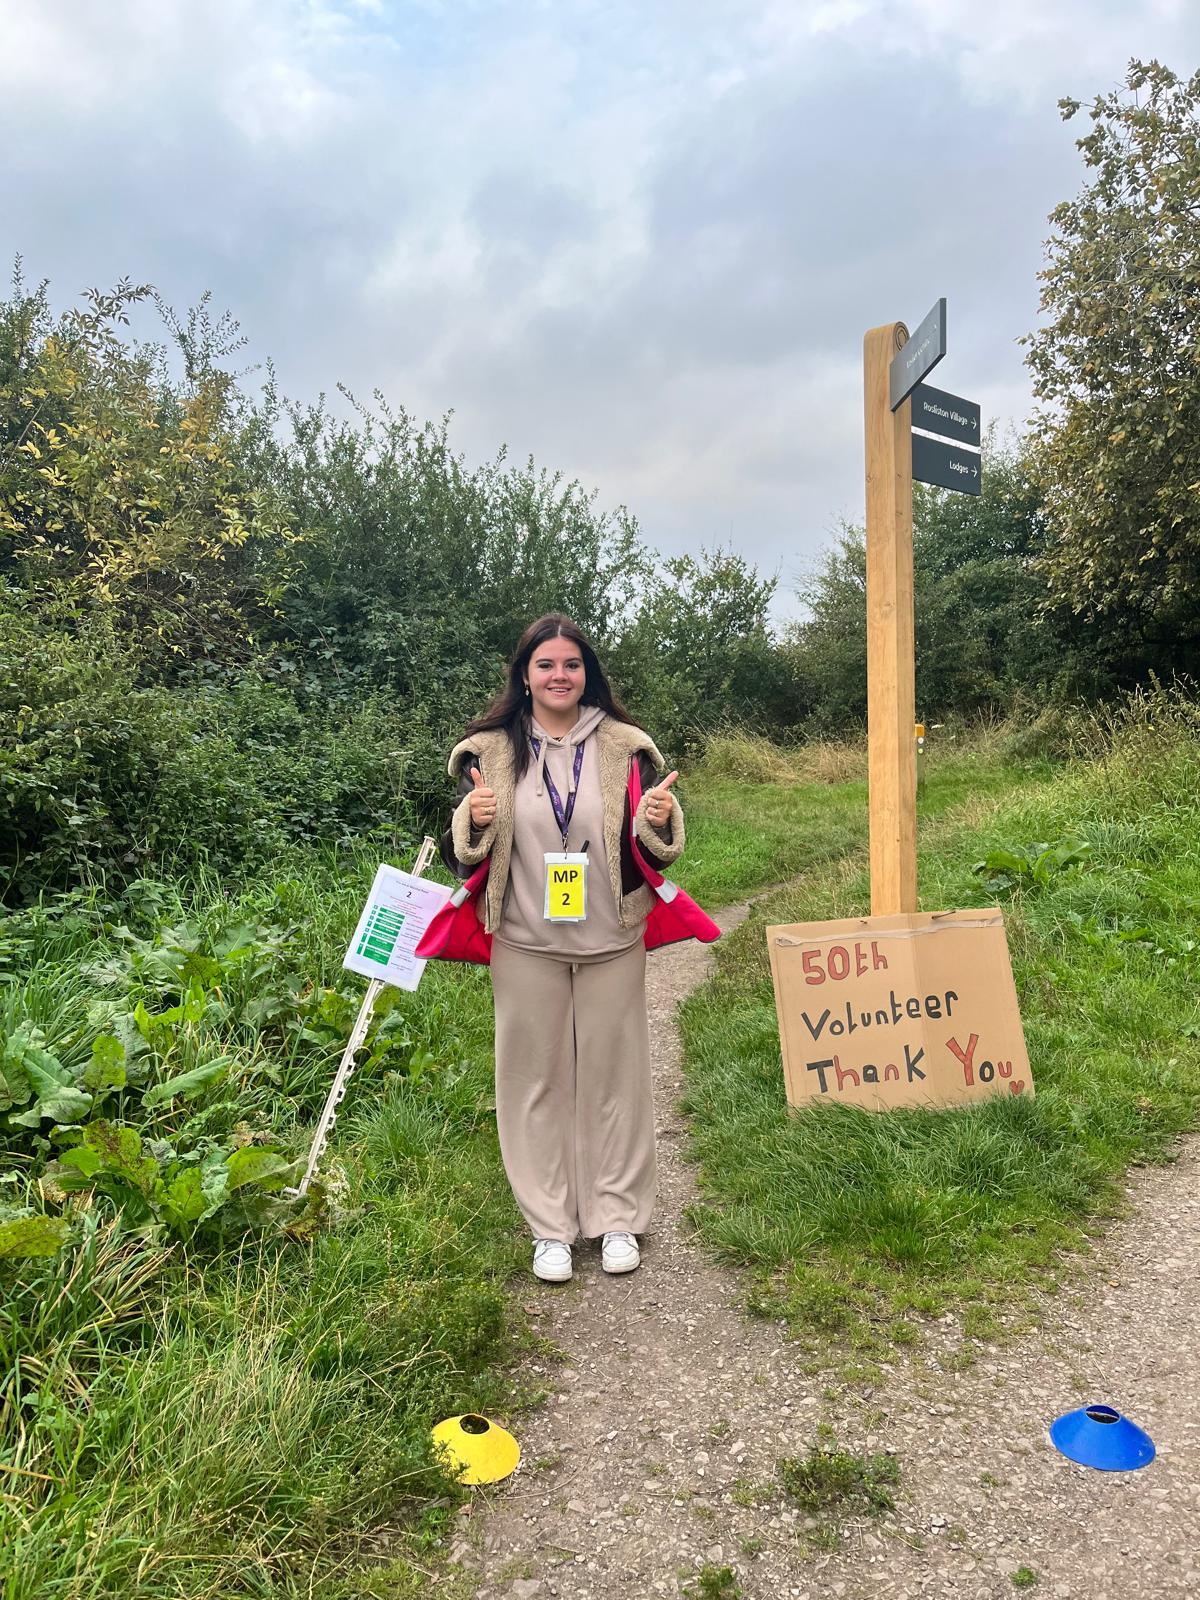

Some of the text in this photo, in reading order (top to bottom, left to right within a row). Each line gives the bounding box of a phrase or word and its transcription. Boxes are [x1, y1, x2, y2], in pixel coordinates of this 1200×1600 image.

[923, 402, 968, 425] Rosliston Village
[949, 460, 969, 474] Lodges
[553, 870, 578, 883] MP
[561, 893, 570, 905] 2
[802, 942, 888, 985] 50th
[801, 990, 959, 1042] Volunteer
[945, 1033, 1012, 1086] You
